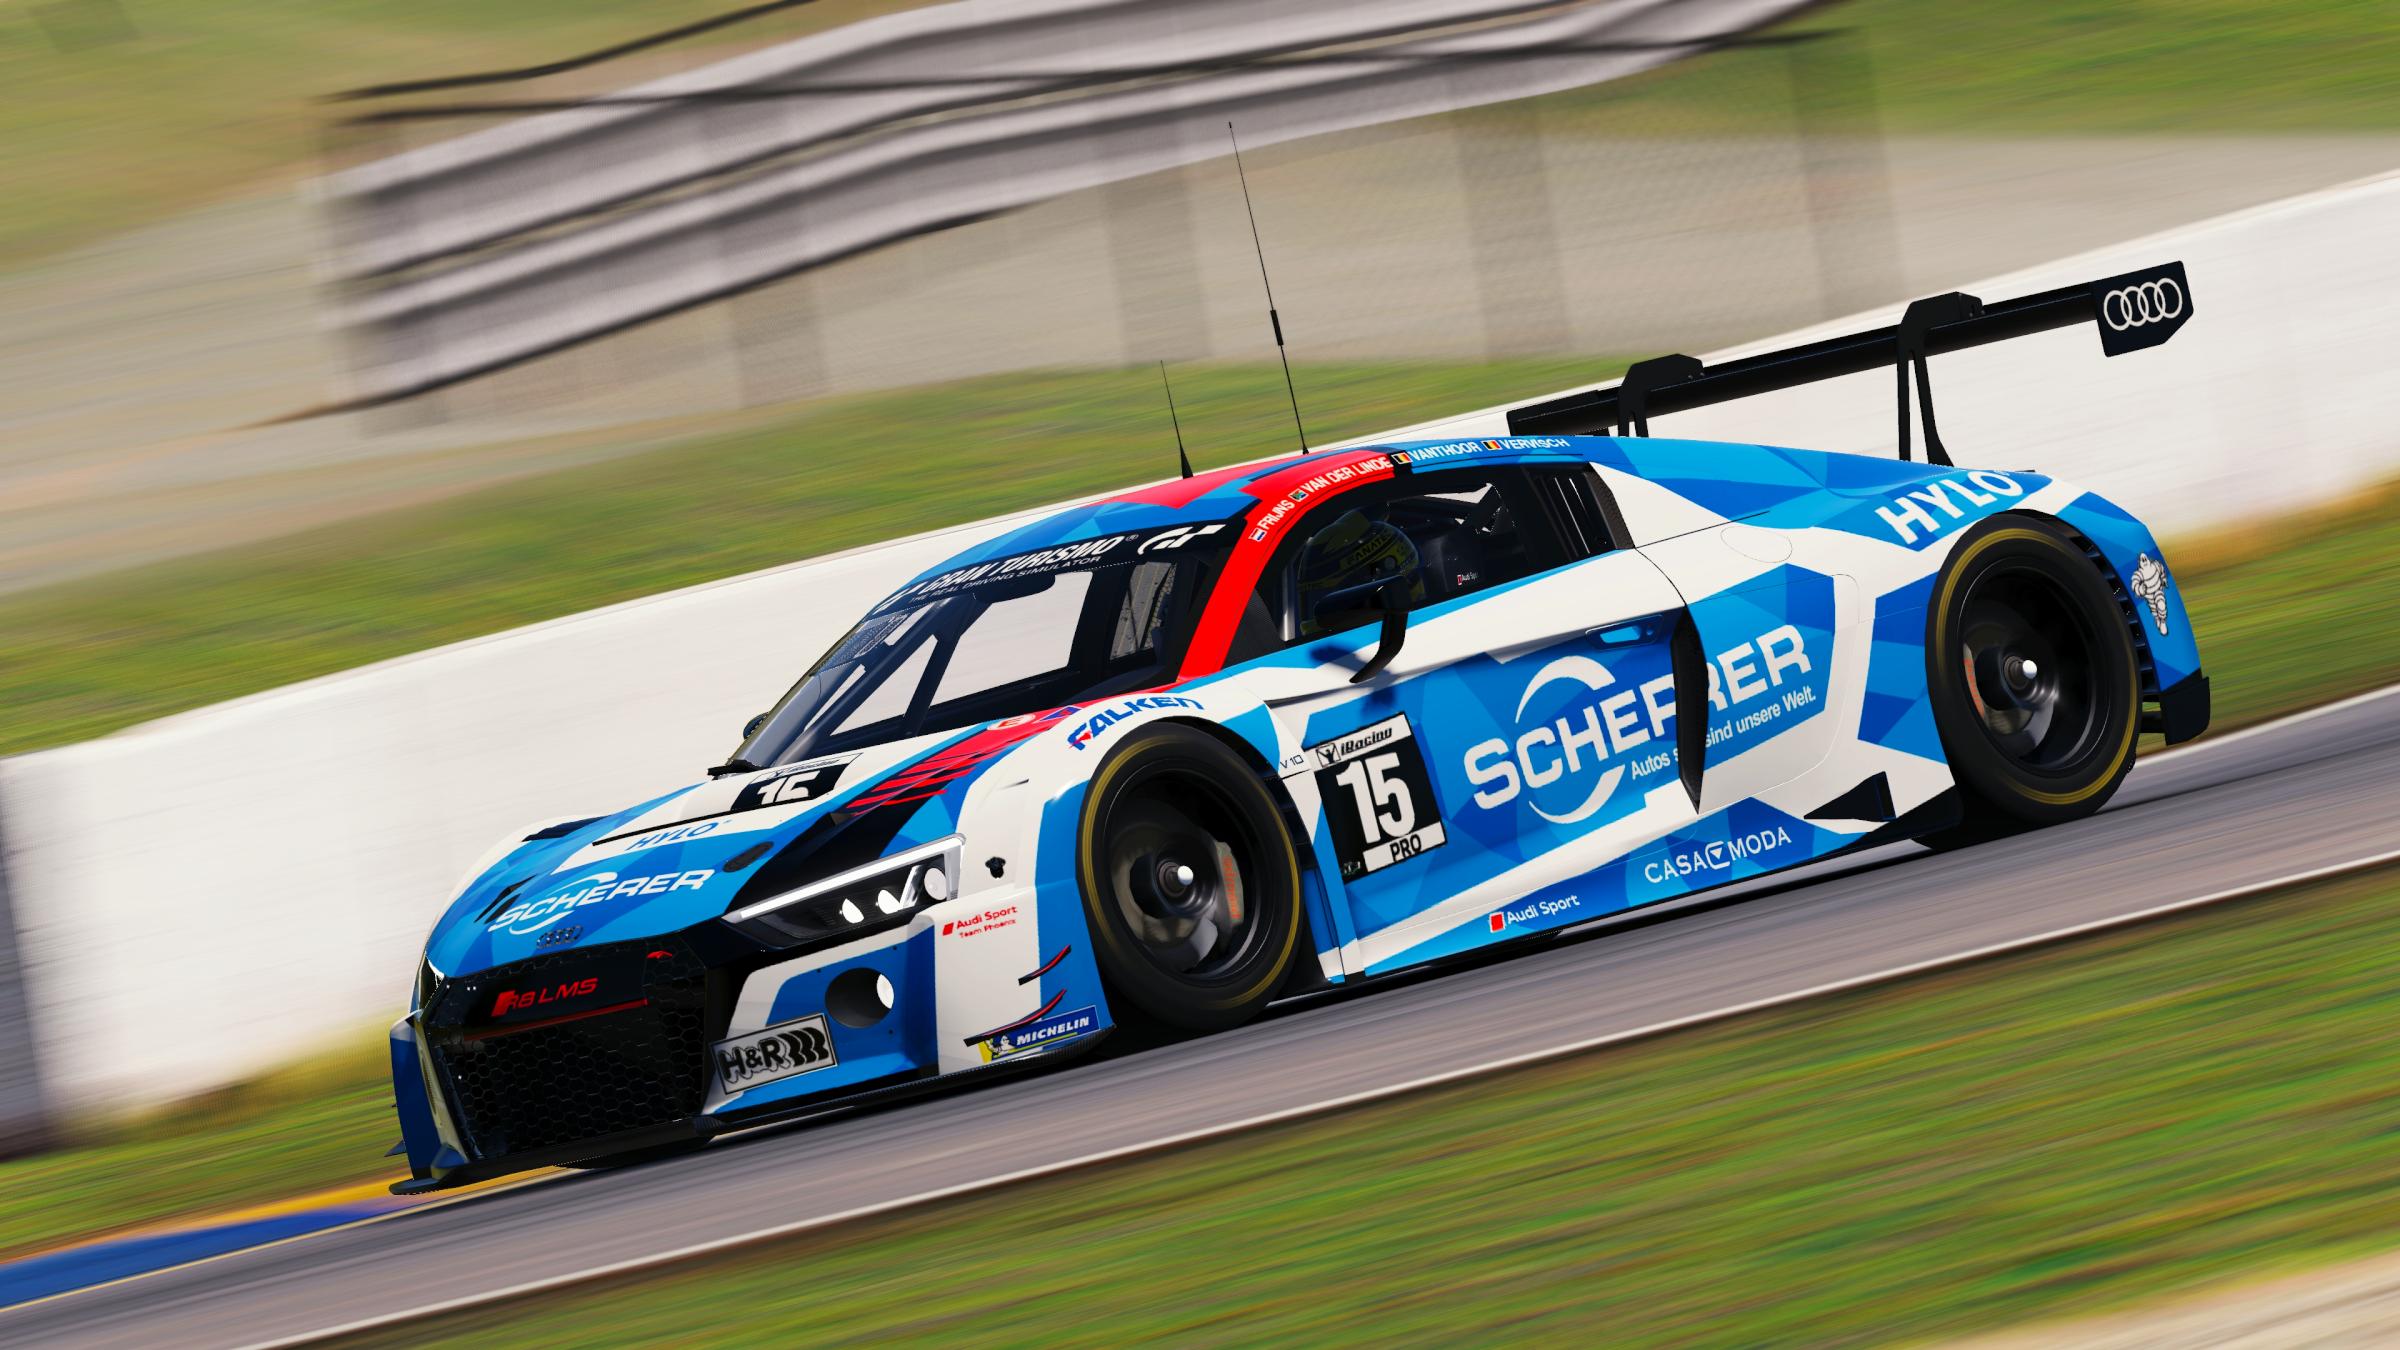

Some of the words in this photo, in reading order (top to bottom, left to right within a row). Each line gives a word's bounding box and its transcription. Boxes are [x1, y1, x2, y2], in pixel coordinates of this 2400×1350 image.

[1408, 442, 1482, 460] VANTHOOR
[1499, 438, 1571, 450] VERVISCH
[1256, 500, 1295, 530] FRIJNS
[1300, 476, 1328, 493] VAN
[1327, 466, 1355, 483] DER
[1352, 456, 1394, 475] LINDE
[1874, 471, 2023, 545] HYLO
[917, 562, 995, 594] GRAN
[989, 536, 1125, 577] TURISMO
[962, 573, 1013, 591] DRIVING
[1016, 555, 1102, 577] SIMULATOR
[1630, 752, 1671, 781] Autos
[1736, 704, 1781, 735] unsere
[1782, 685, 1816, 713] Welt.
[1335, 752, 1416, 844] 15
[625, 821, 719, 851] HYLO
[1389, 834, 1422, 862] PRO
[487, 869, 715, 933] SCHERER
[956, 914, 983, 930] Audi
[984, 906, 1018, 922] Sport
[1507, 905, 1537, 925] Audi
[1539, 894, 1580, 918] Sport
[538, 977, 598, 1004] LMS
[1016, 1016, 1090, 1046] MICHELIN
[719, 1037, 790, 1083] H&R
